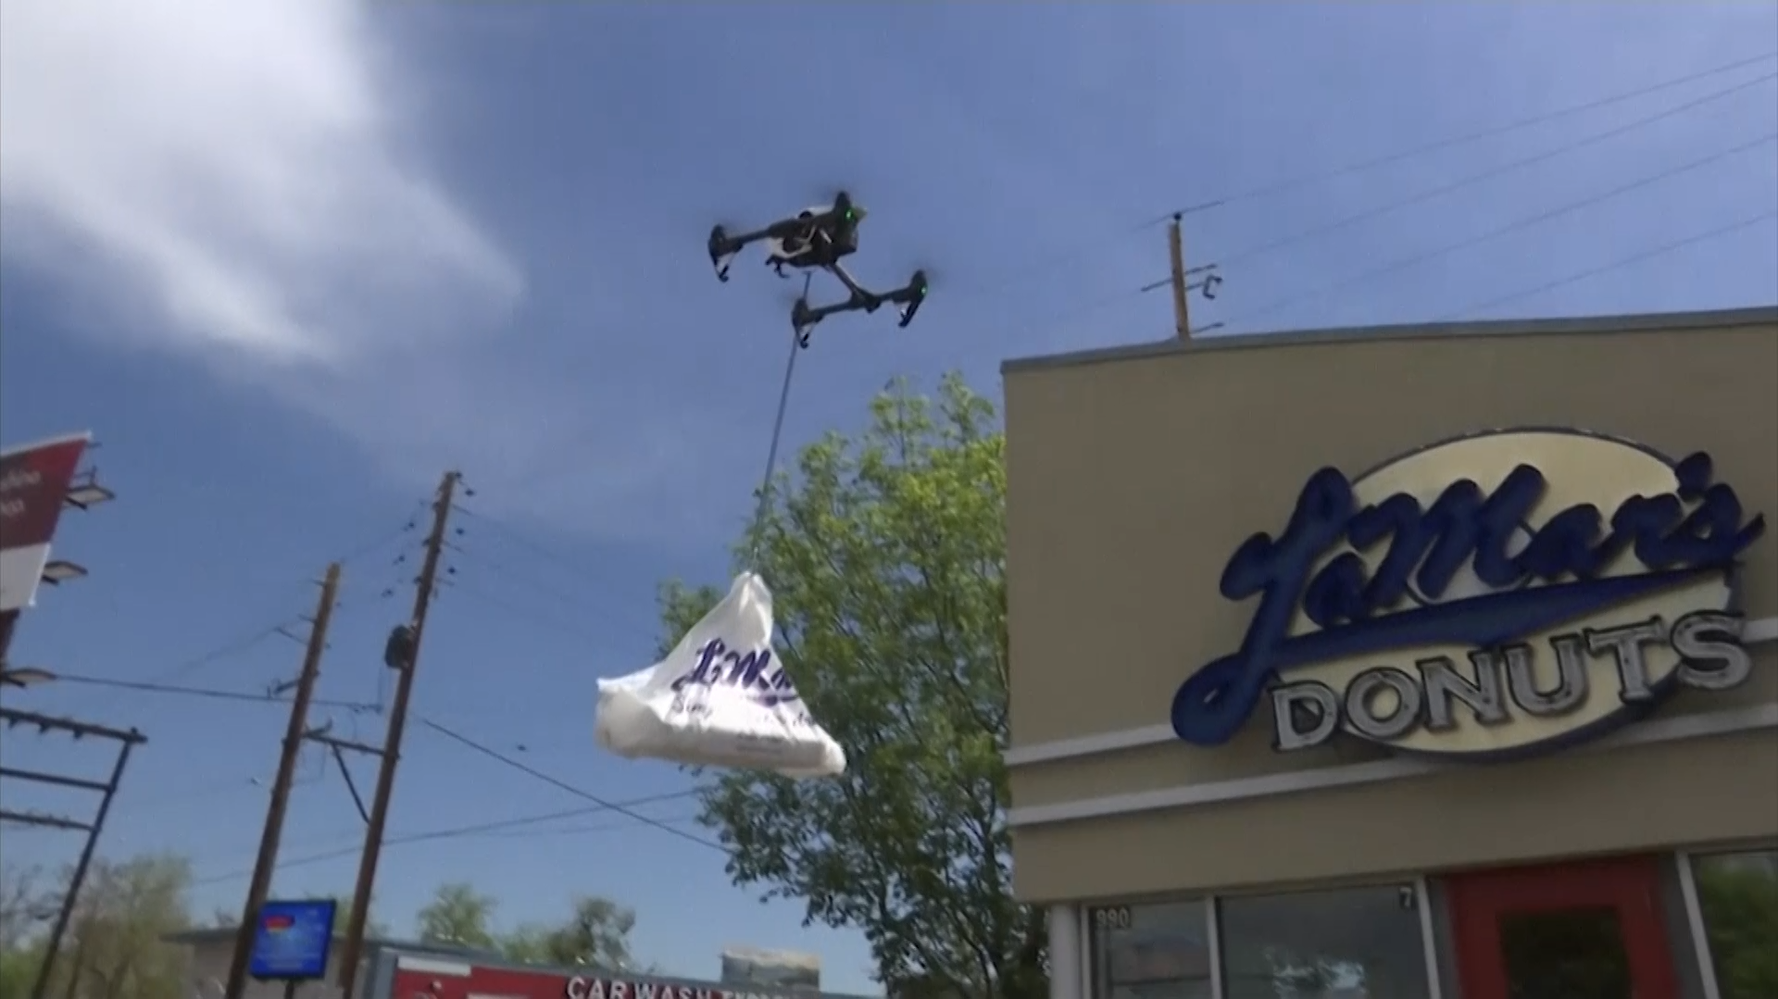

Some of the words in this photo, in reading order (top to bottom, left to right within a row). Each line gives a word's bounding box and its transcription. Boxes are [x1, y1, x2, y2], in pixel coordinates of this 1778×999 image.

[1171, 451, 1765, 746] LaMar's
[1271, 610, 1752, 753] DONUTS
[567, 976, 630, 999] CAR
